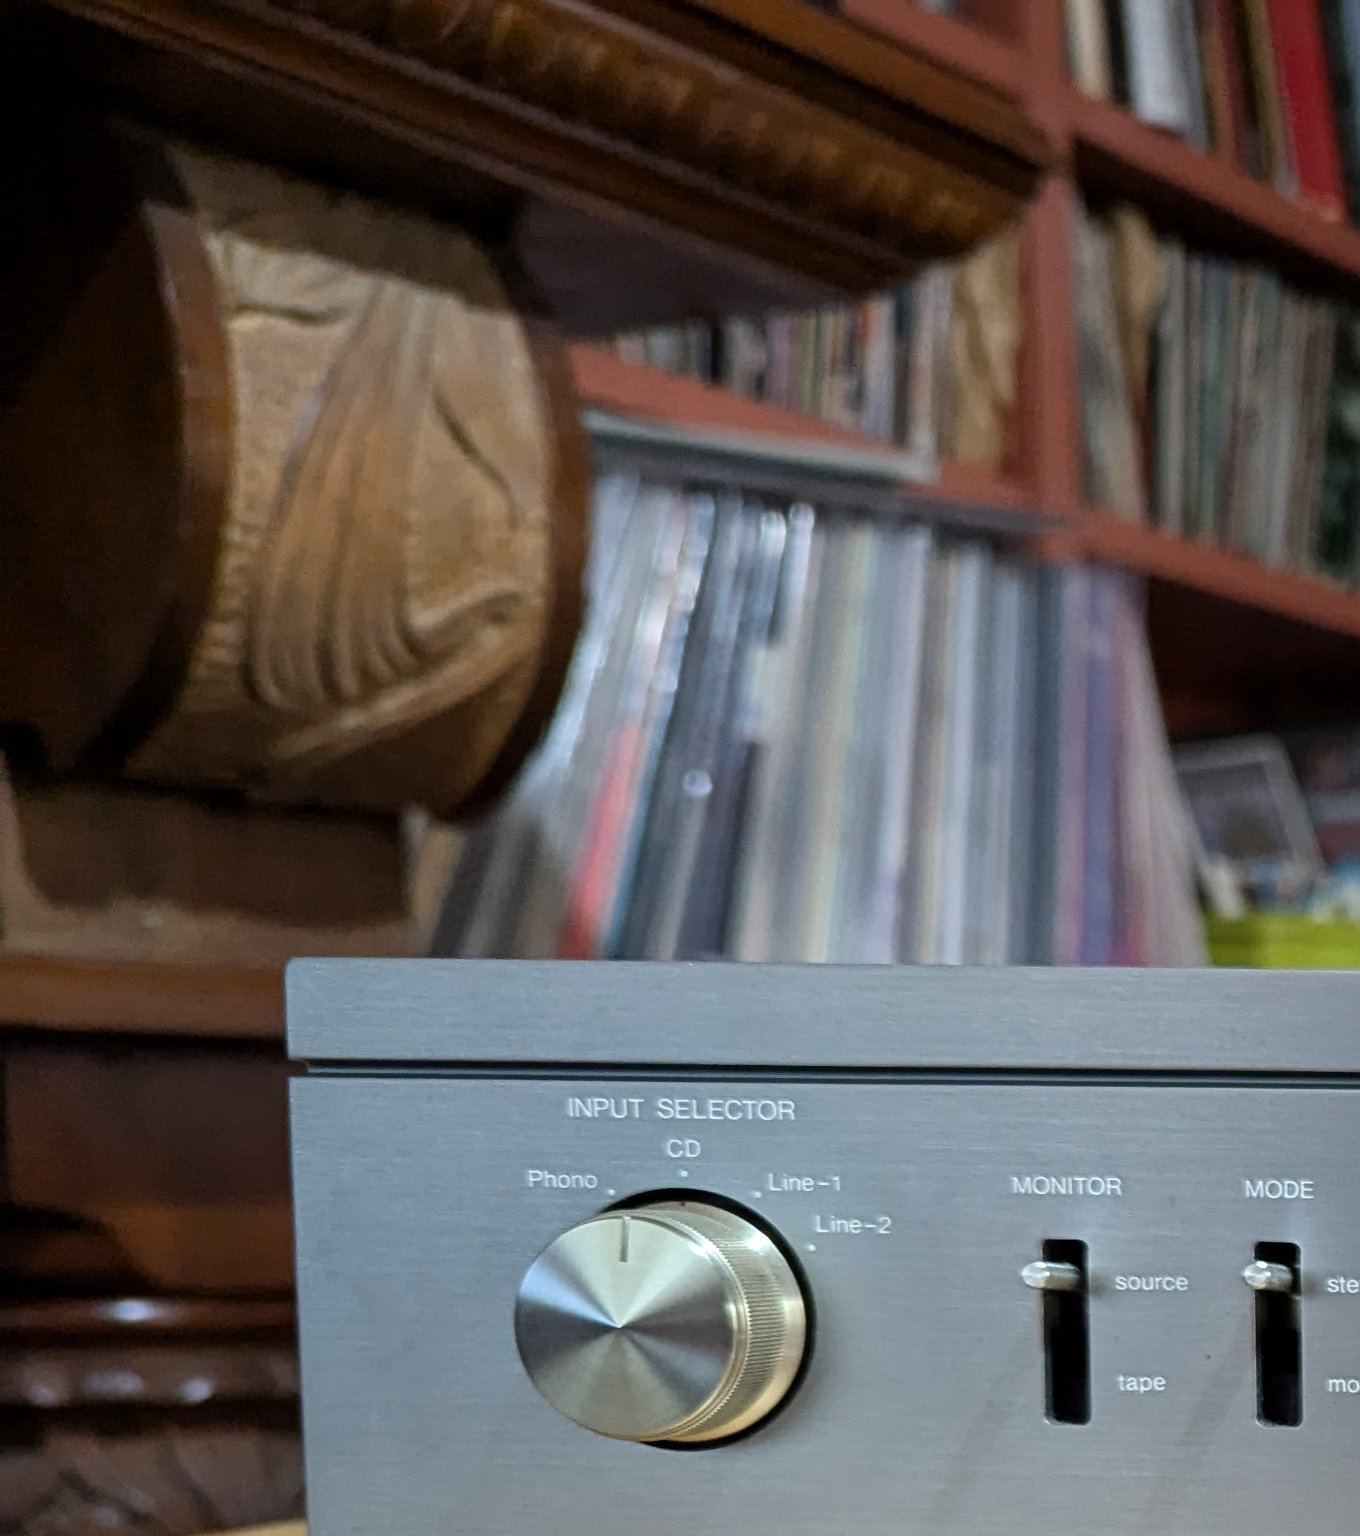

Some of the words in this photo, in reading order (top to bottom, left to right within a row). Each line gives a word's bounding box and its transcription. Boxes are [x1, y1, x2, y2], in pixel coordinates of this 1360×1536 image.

[567, 1098, 645, 1119] INPUT
[656, 1099, 796, 1121] SELECTOR
[666, 1139, 700, 1159] CD
[528, 1169, 598, 1190] Phono
[767, 1173, 841, 1192] Line-1
[1010, 1176, 1123, 1197] MONITOR
[1243, 1180, 1314, 1200] MODE
[815, 1215, 892, 1235] Line-2
[1115, 1274, 1189, 1292] source
[1118, 1374, 1167, 1394] tape
